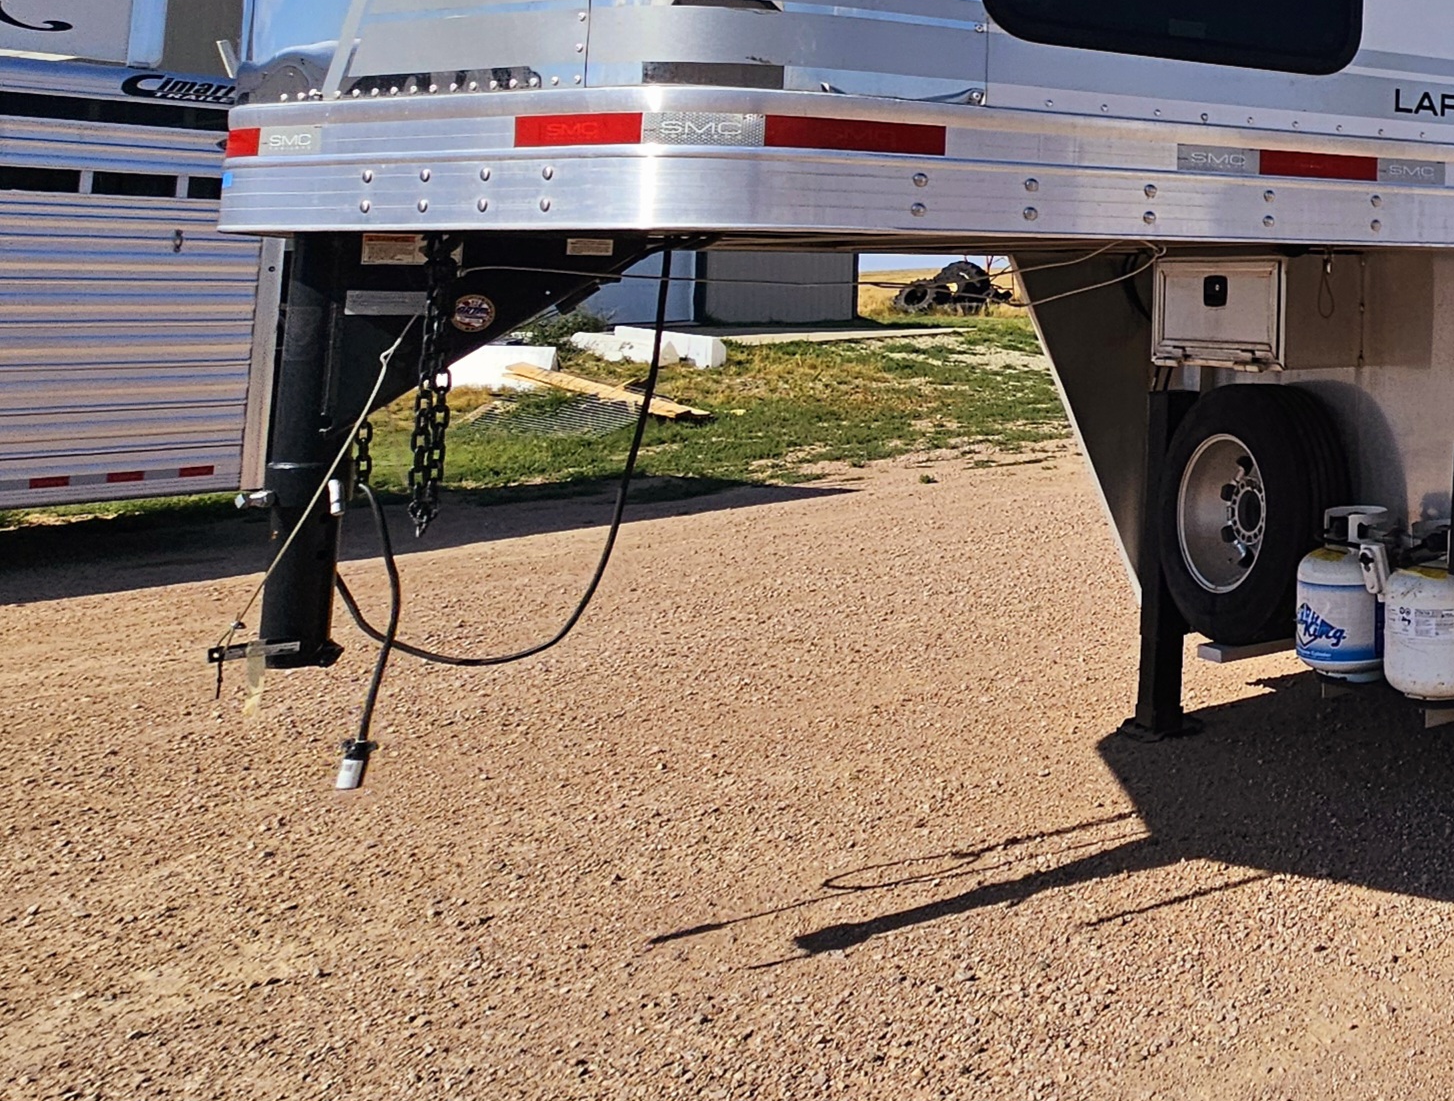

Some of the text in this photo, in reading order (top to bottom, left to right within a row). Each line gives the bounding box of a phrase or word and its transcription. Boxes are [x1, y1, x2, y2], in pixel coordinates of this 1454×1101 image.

[660, 120, 741, 135] SMC
[269, 133, 311, 147] SMC
[1191, 152, 1246, 166] SMC
[1388, 164, 1435, 177] SMC
